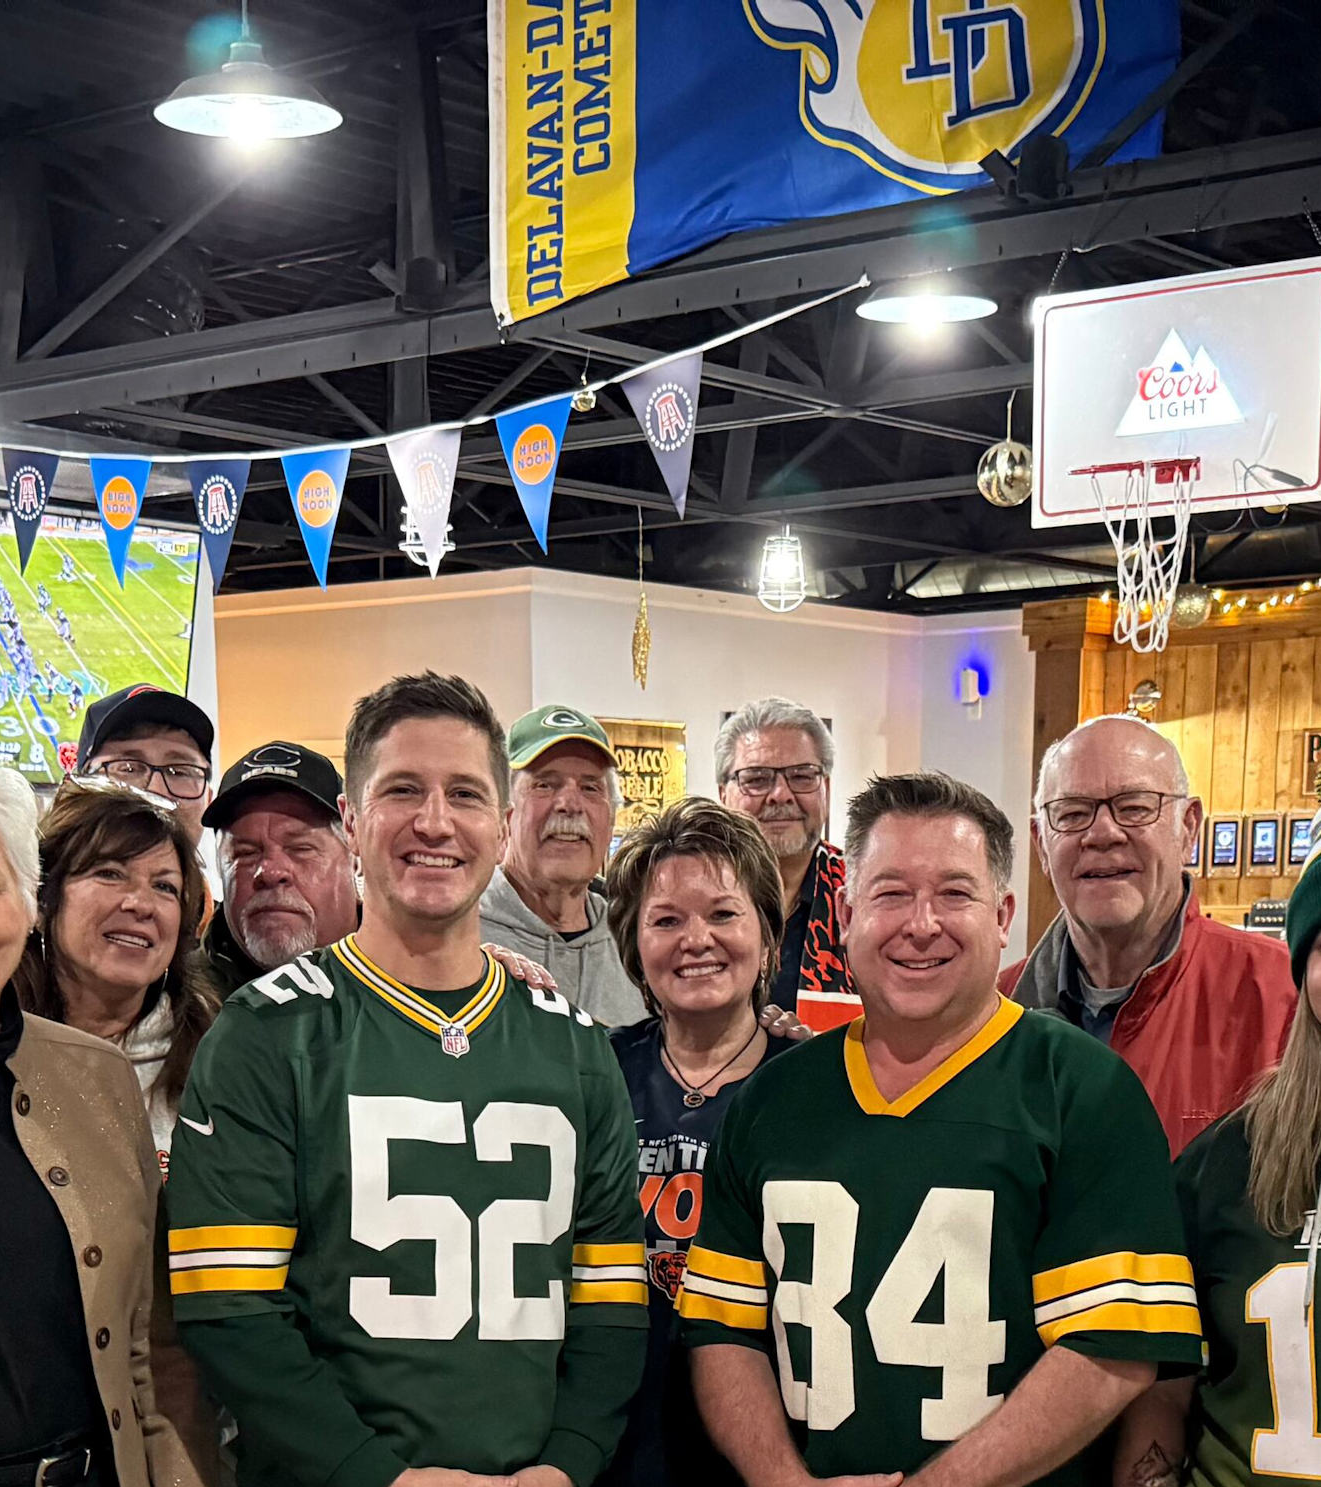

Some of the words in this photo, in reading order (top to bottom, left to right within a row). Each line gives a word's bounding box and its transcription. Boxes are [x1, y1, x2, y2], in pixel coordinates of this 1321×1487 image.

[527, 0, 565, 306] DELAVAN-D
[1137, 366, 1218, 401] Coors
[1149, 397, 1207, 420] LIGHT
[519, 439, 548, 456] HIGH
[518, 451, 551, 469] NOON
[304, 487, 330, 498] HIGH
[302, 499, 332, 511] NOON
[616, 748, 671, 773] OBACCO
[447, 1037, 466, 1052] NFL
[649, 1138, 667, 1147] NFC
[347, 1094, 577, 1341] 52
[763, 1180, 1007, 1441] 84
